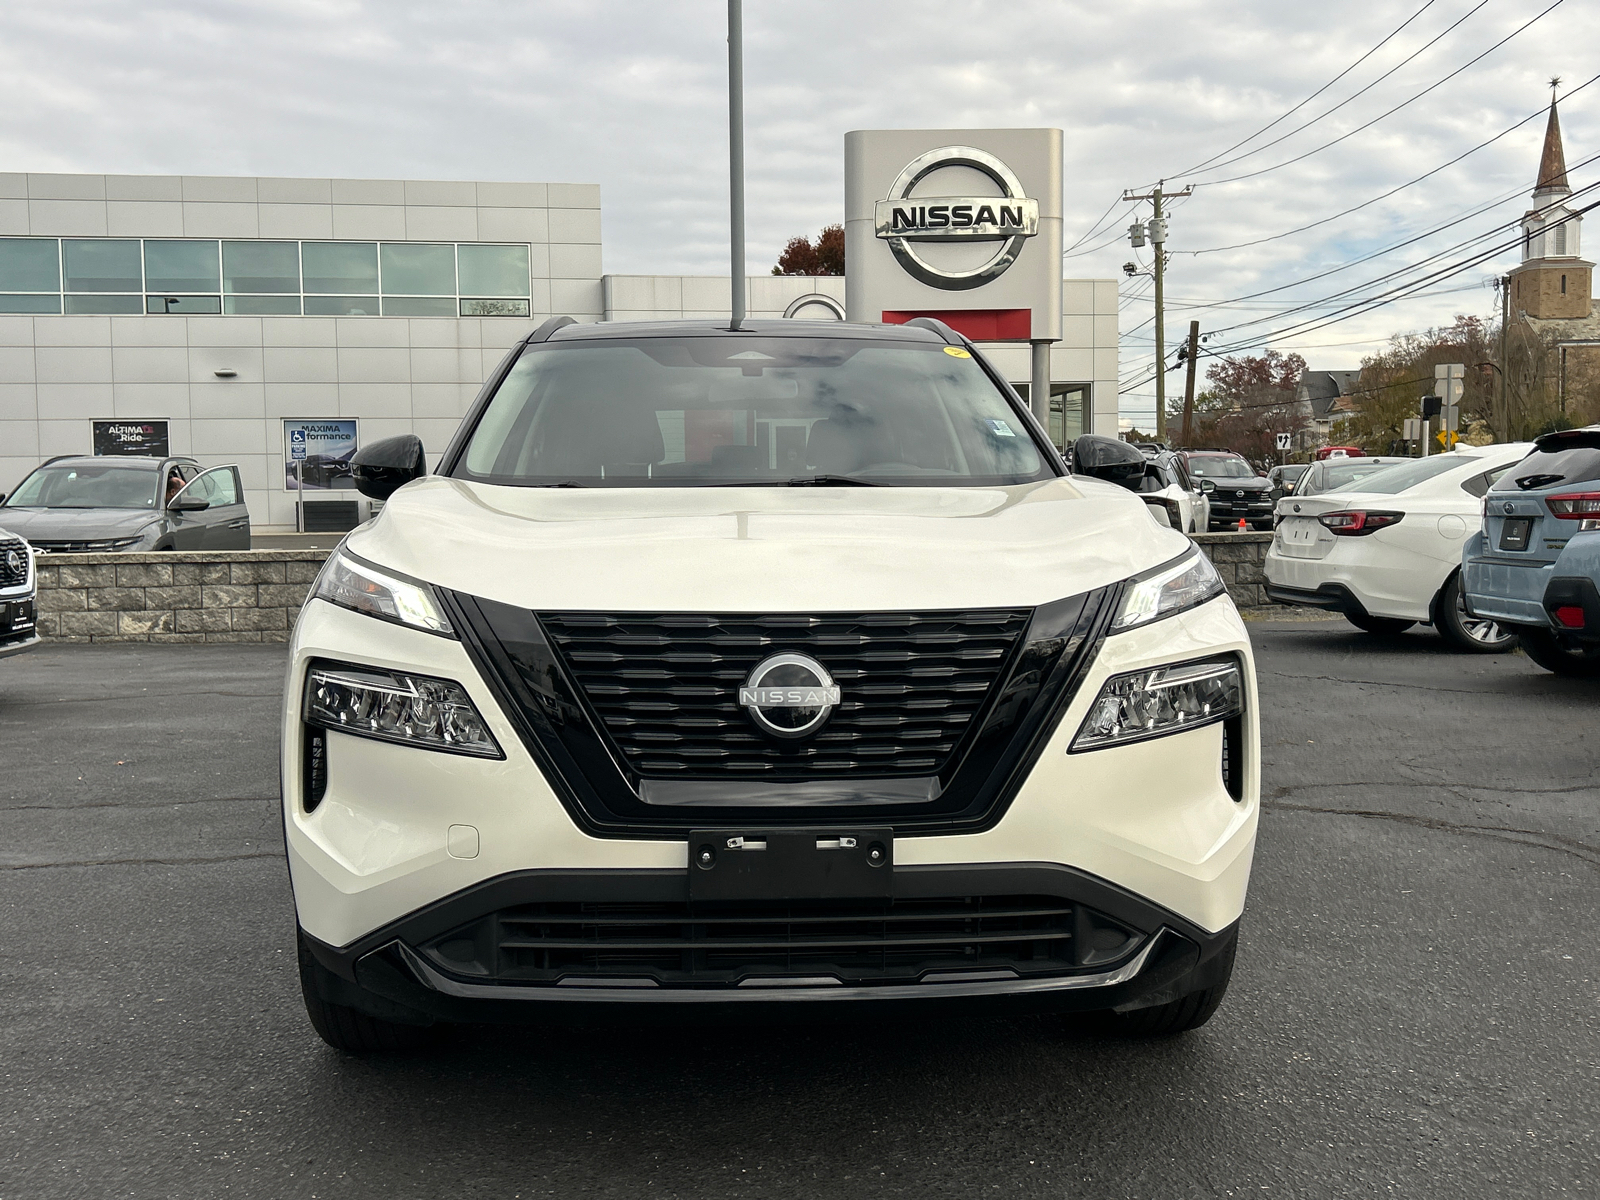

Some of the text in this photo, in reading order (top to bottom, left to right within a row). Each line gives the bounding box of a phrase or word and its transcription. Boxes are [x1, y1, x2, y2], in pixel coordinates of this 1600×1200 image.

[892, 205, 1023, 228] NISSAN
[301, 425, 341, 433] MAXIMA
[120, 433, 143, 442] Ride
[306, 432, 351, 440] formance
[742, 690, 838, 703] NISSAN
